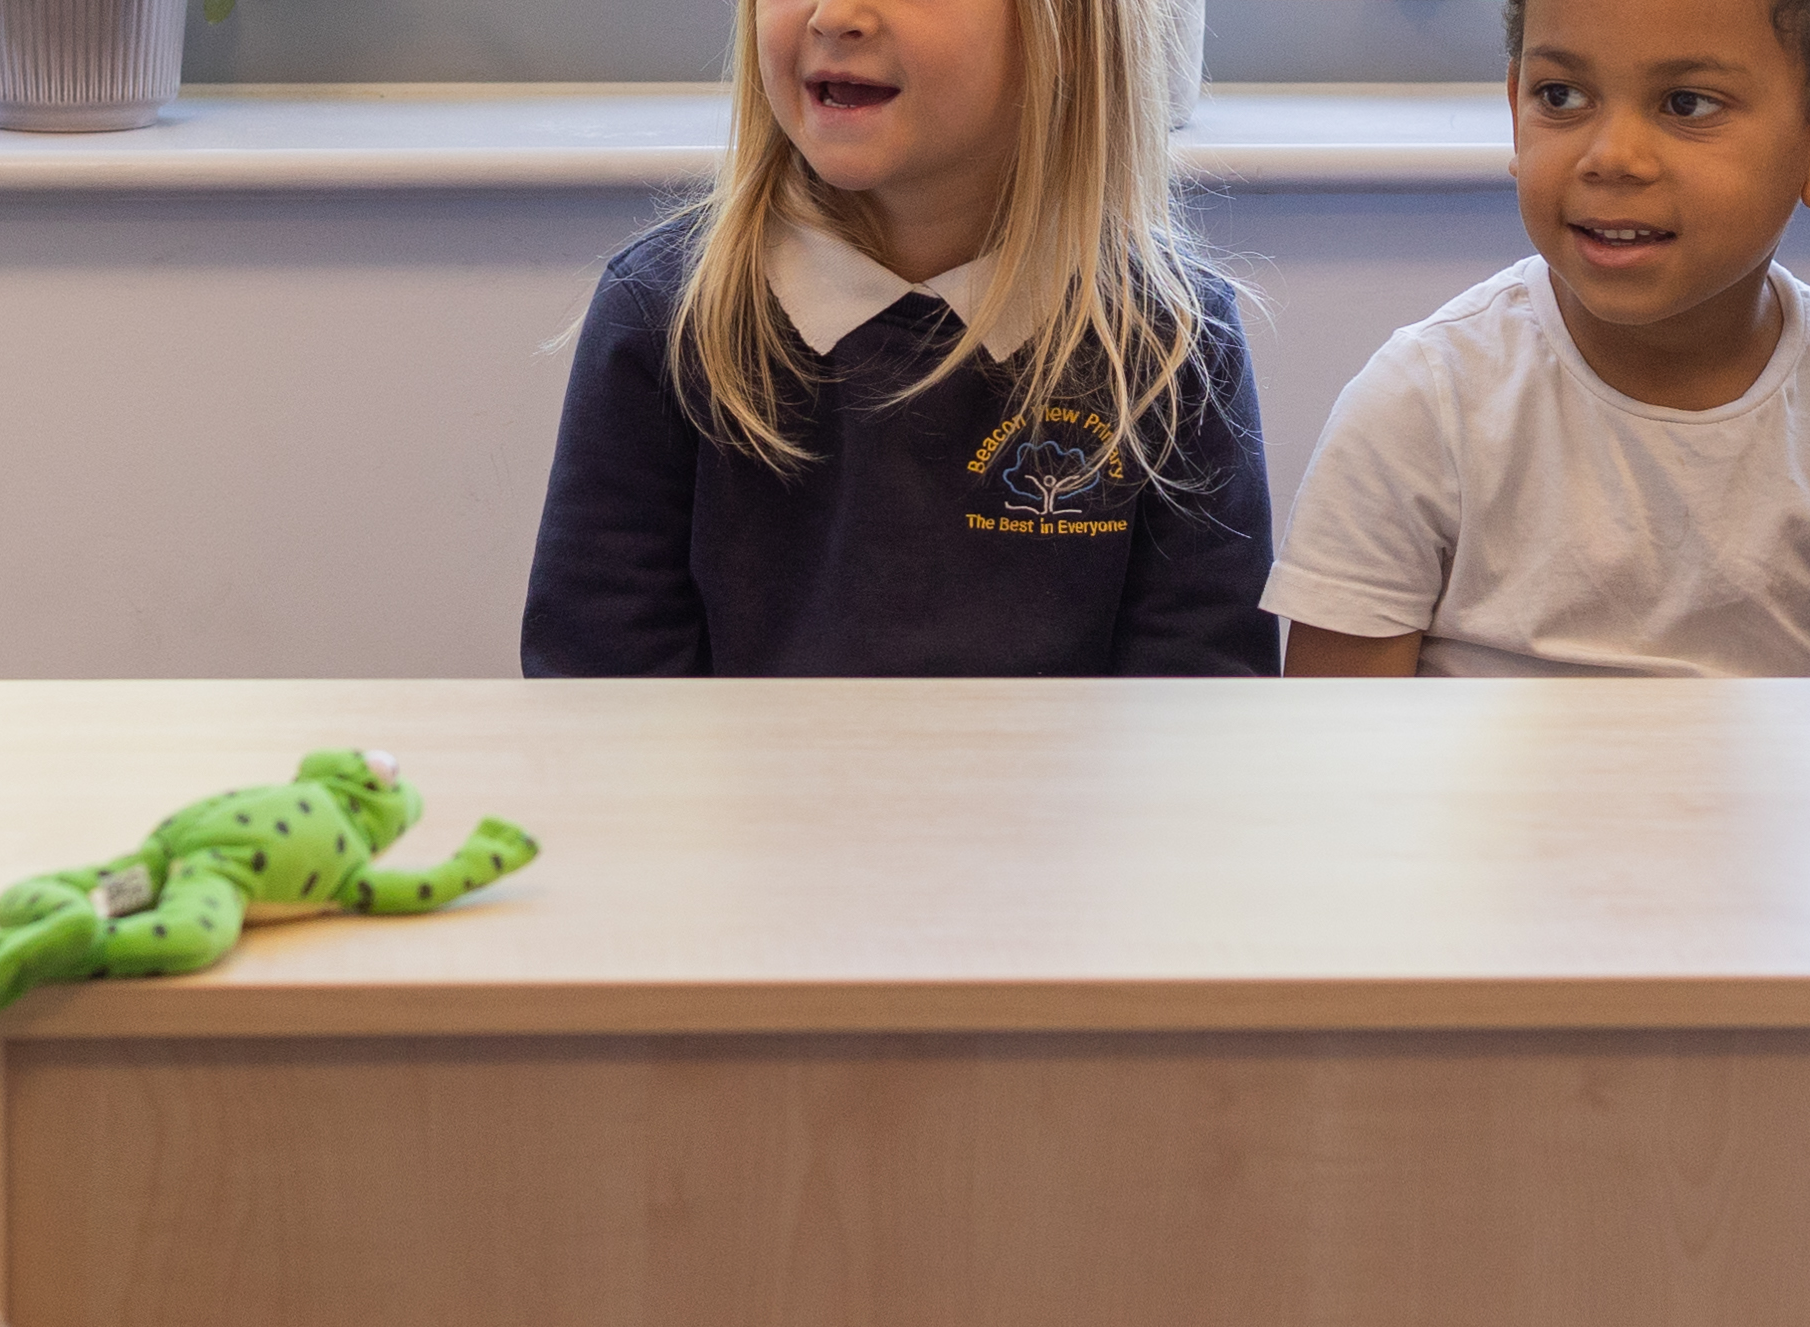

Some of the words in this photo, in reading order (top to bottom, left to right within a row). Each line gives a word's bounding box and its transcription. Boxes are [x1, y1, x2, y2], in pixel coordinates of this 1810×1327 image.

[967, 413, 1026, 474] Beacon
[966, 514, 996, 531] The
[999, 517, 1035, 534] Best
[1040, 518, 1054, 534] in
[1058, 518, 1128, 537] Everyone
